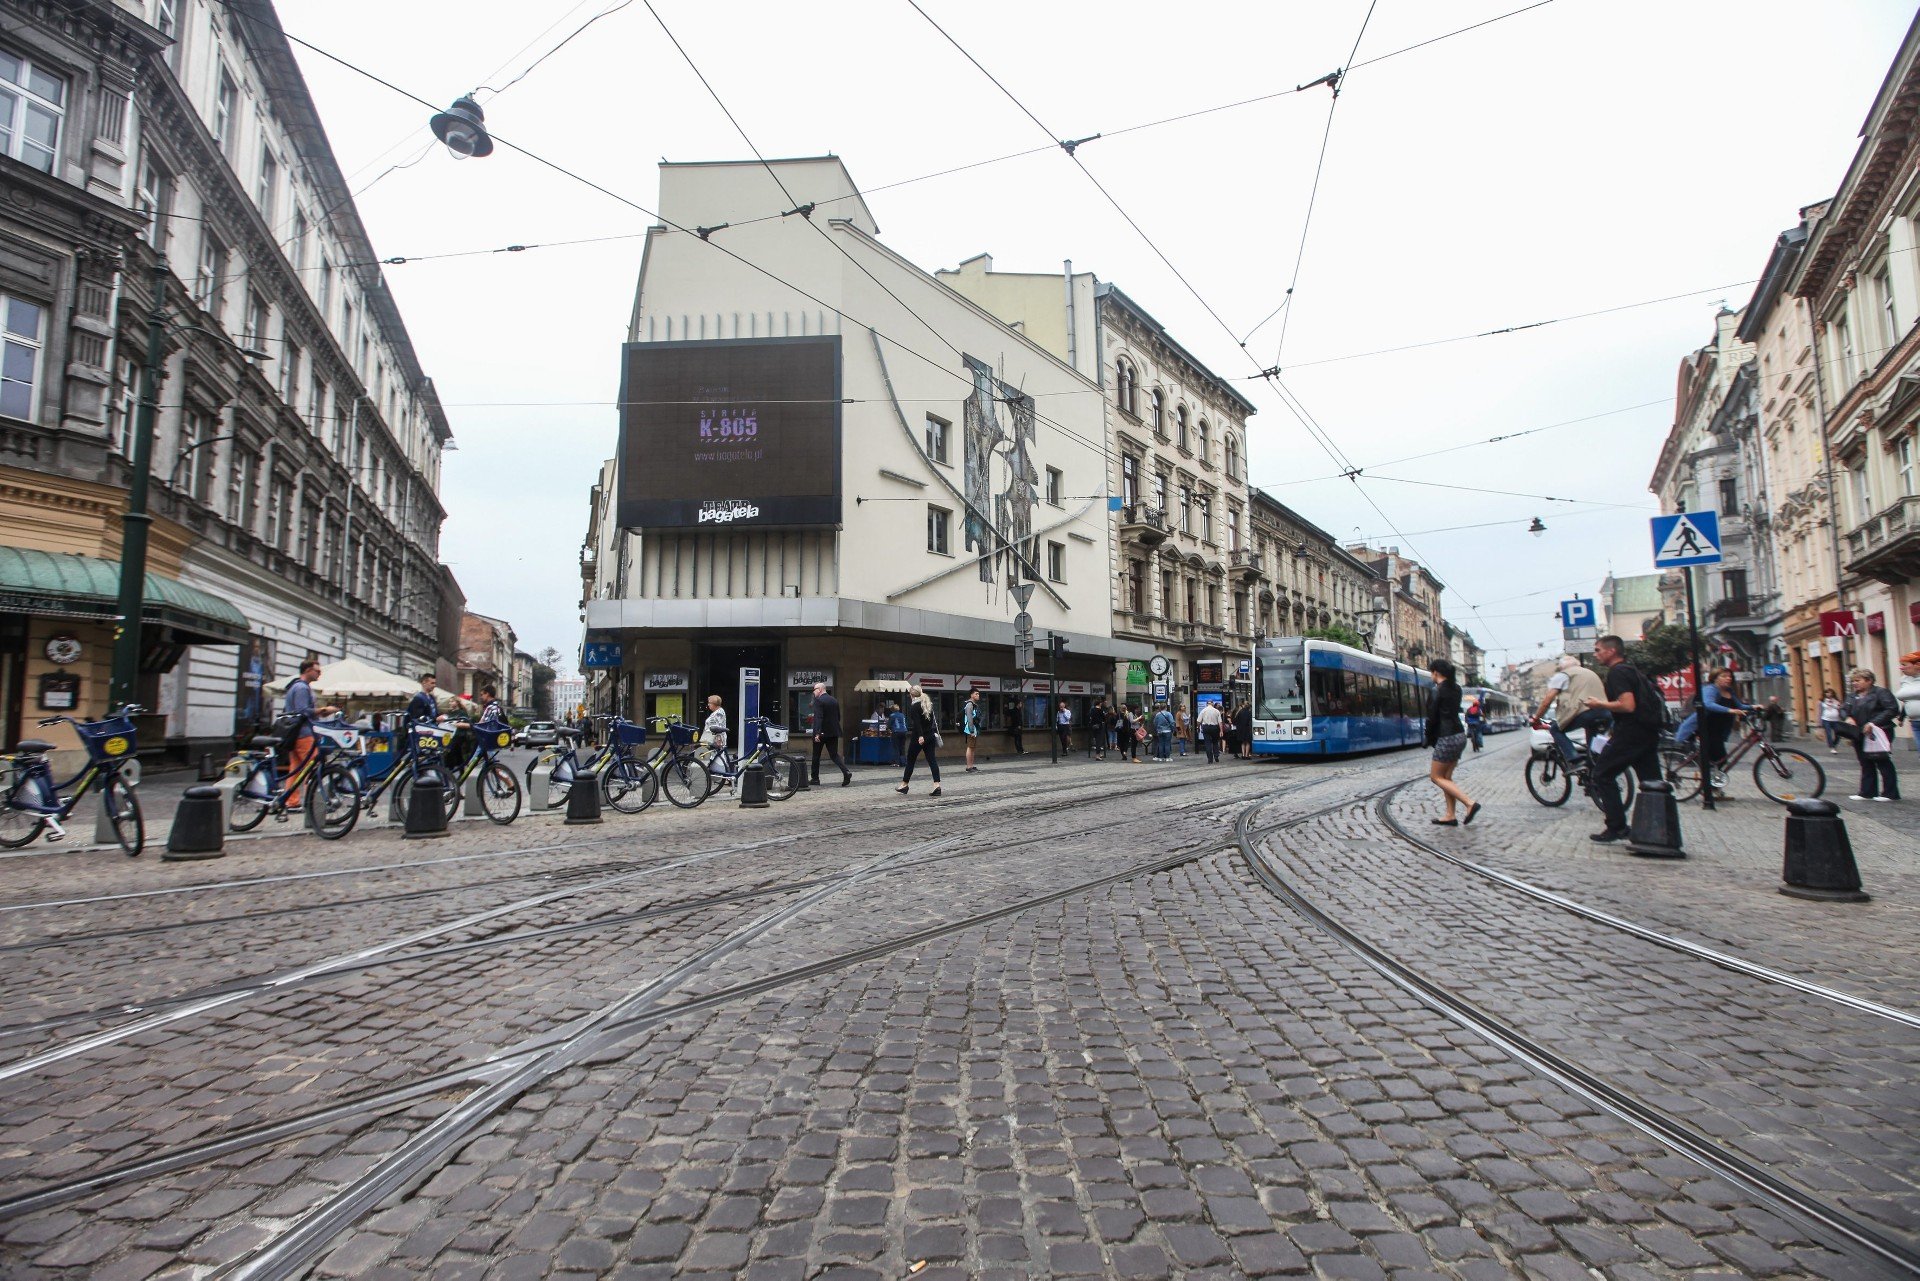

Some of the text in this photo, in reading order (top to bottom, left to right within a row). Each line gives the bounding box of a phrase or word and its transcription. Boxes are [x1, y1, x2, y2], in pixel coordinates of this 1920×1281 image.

[698, 504, 759, 523] bagatela
[1567, 602, 1588, 625] P
[1832, 621, 1855, 636] M
[649, 678, 683, 688] bagatela
[792, 675, 828, 685] bagatela
